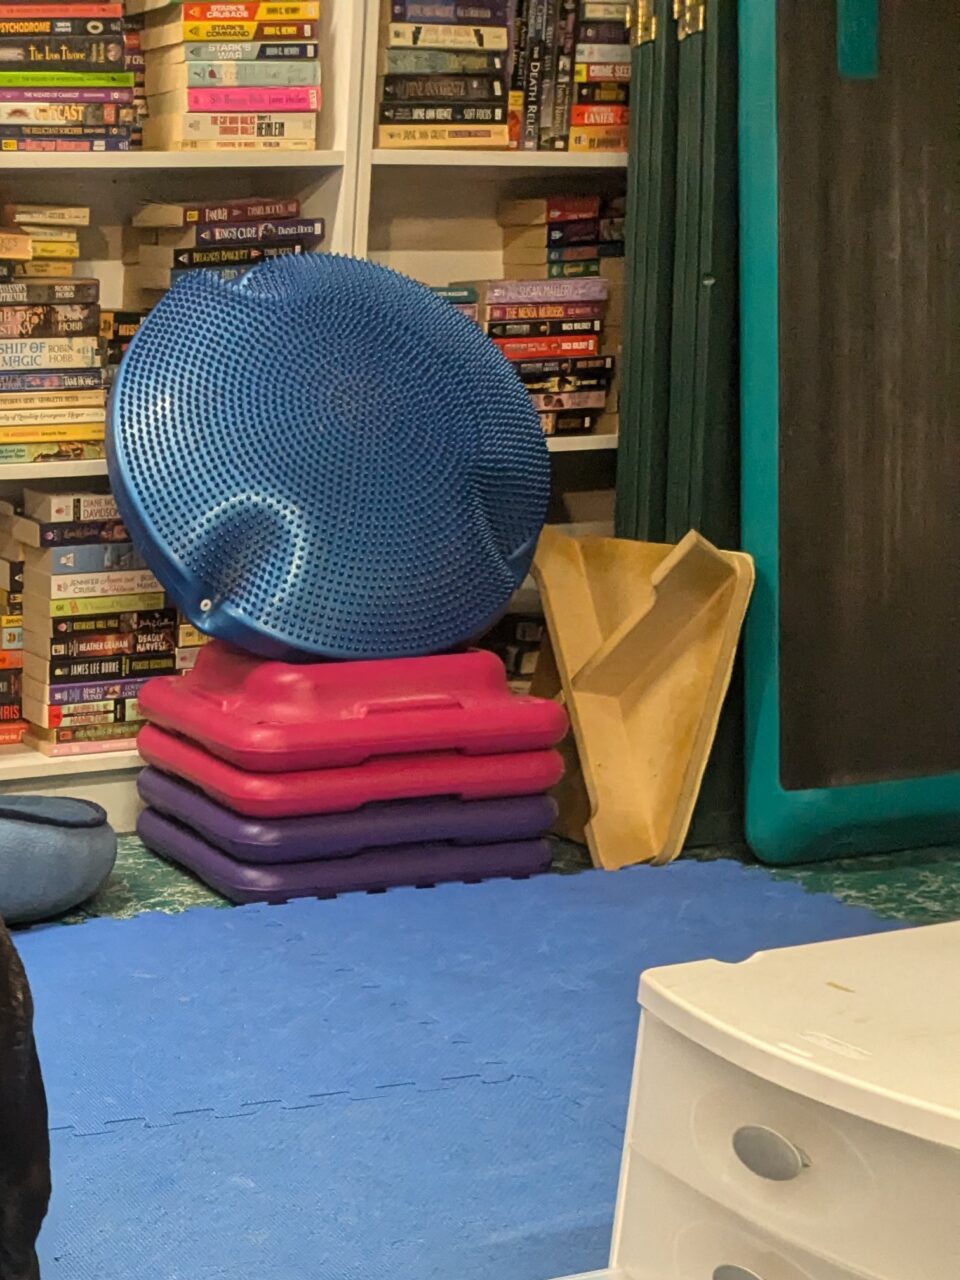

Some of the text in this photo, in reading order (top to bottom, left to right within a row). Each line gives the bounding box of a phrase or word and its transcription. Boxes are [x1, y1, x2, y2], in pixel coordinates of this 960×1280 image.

[28, 45, 43, 60] The
[527, 62, 540, 101] DEATH
[525, 104, 537, 137] RELIC
[57, 321, 83, 332] HOBB
[29, 341, 46, 354] OF
[48, 344, 74, 354] ROBIN
[48, 354, 74, 364] HOBB
[137, 632, 164, 643] DEADLY
[79, 641, 104, 652] HEATHER
[104, 640, 129, 650] GRAHAM
[70, 661, 119, 676] JAMES LEE BURKE
[1, 704, 20, 718] IRIS
